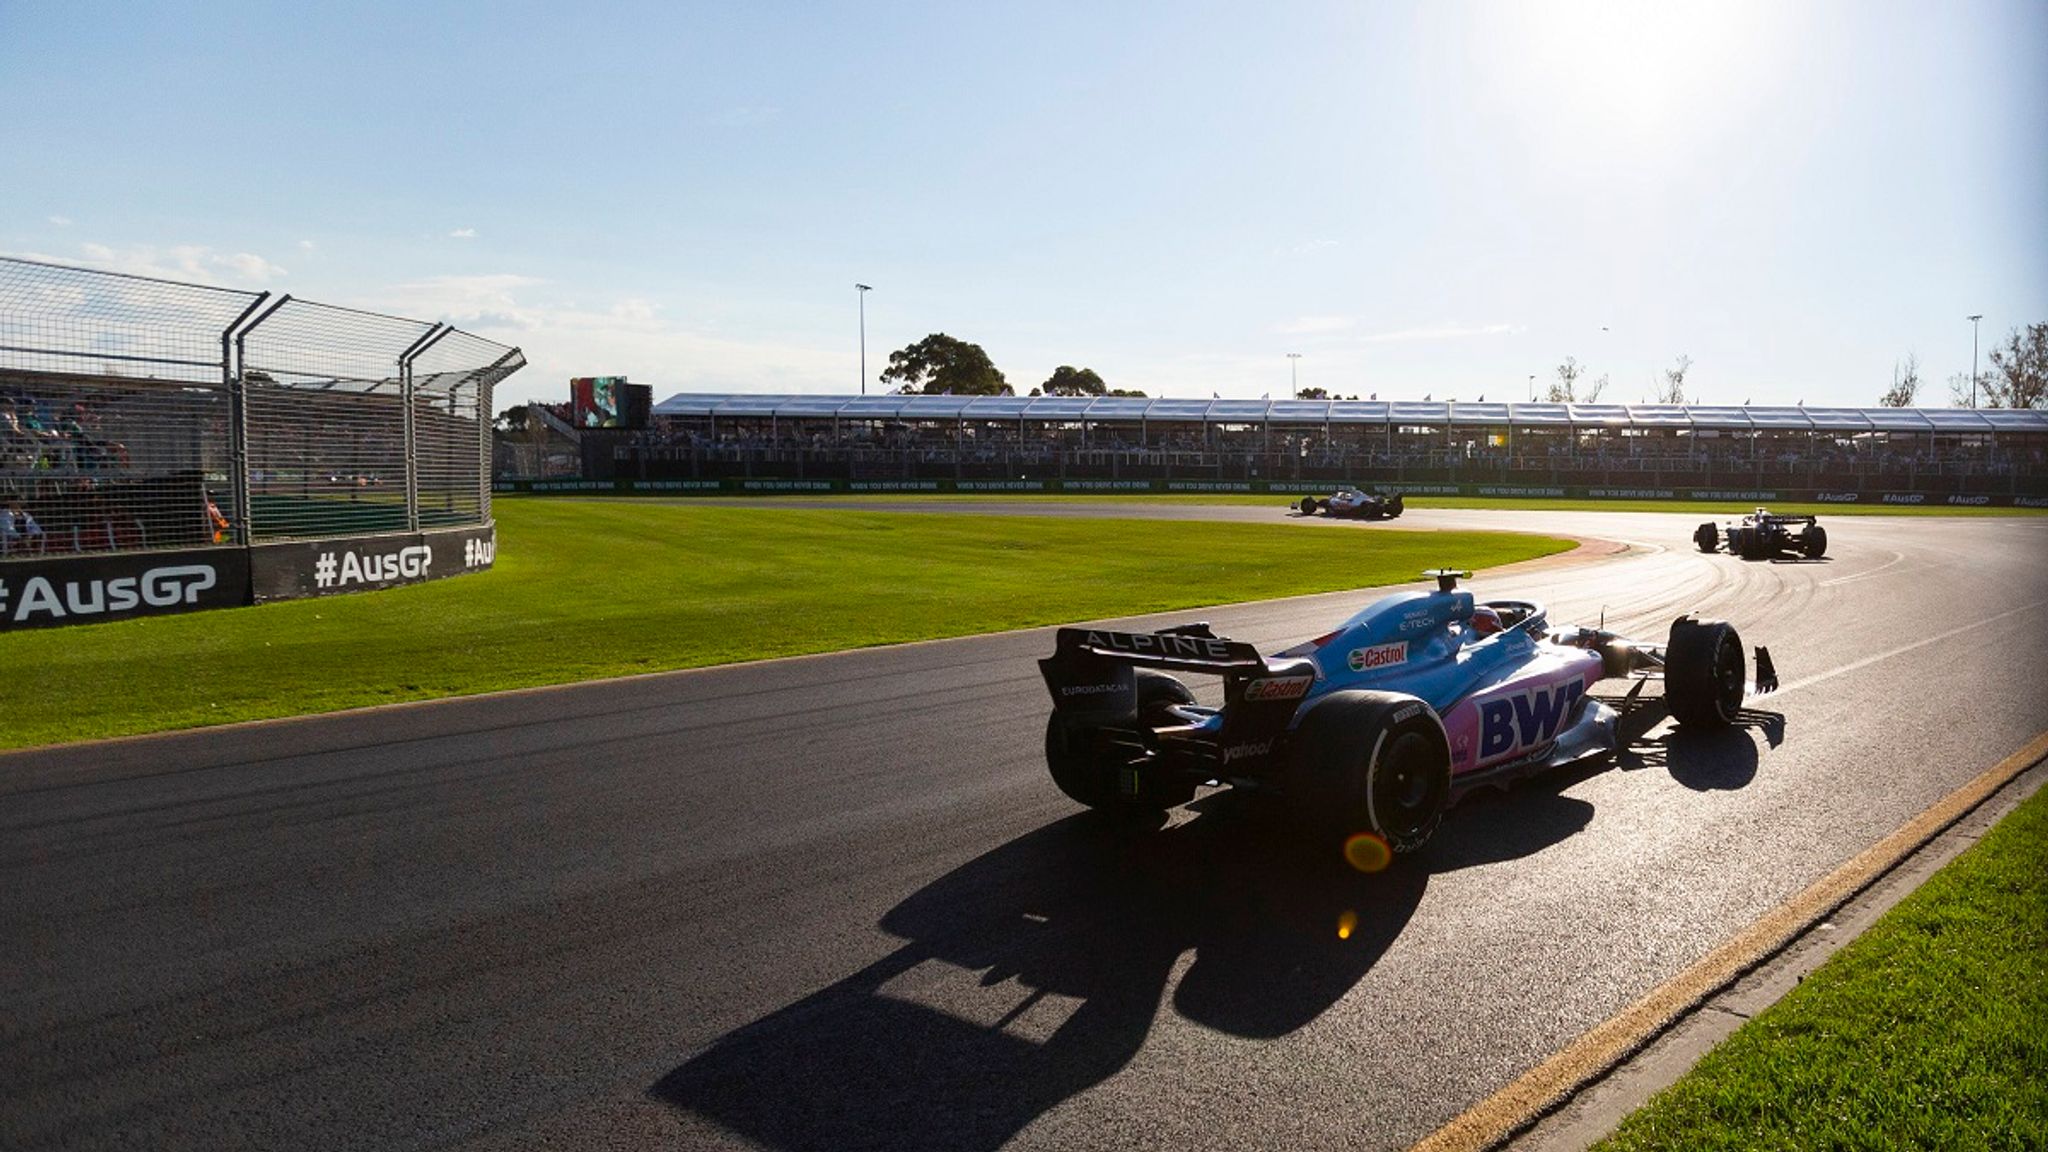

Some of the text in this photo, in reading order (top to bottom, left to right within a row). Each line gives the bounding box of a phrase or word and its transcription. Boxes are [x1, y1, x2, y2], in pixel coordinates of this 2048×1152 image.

[1817, 493, 1858, 502] #AusGP
[1882, 494, 1924, 503] #AusGP
[1948, 495, 1989, 504] #AusGP
[314, 545, 432, 588] #AusGP
[0, 564, 216, 620] AusGP
[1086, 630, 1231, 657] ALPINE
[1365, 645, 1405, 667] Castrol
[1260, 679, 1308, 697] Castrol
[1223, 736, 1274, 766] yahoo!
